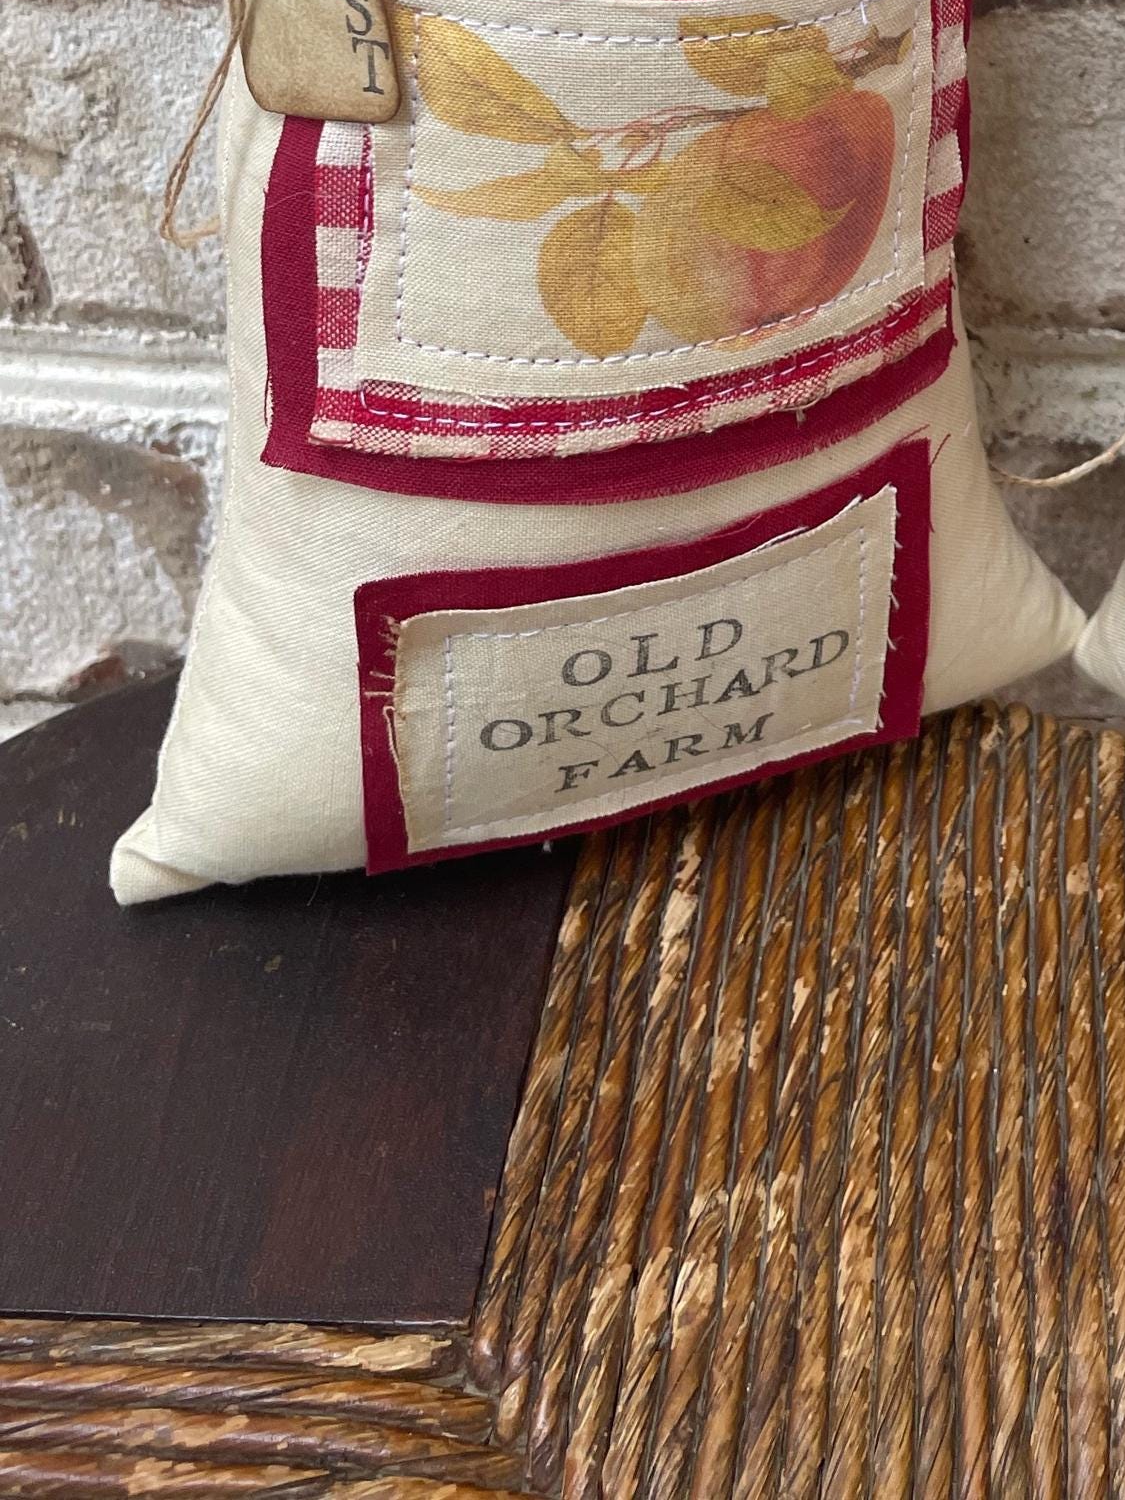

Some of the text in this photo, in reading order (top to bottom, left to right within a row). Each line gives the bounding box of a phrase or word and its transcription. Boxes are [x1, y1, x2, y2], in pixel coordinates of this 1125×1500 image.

[479, 629, 850, 752] ORCHARD
[561, 618, 743, 687] OLD
[554, 712, 775, 793] FARM
